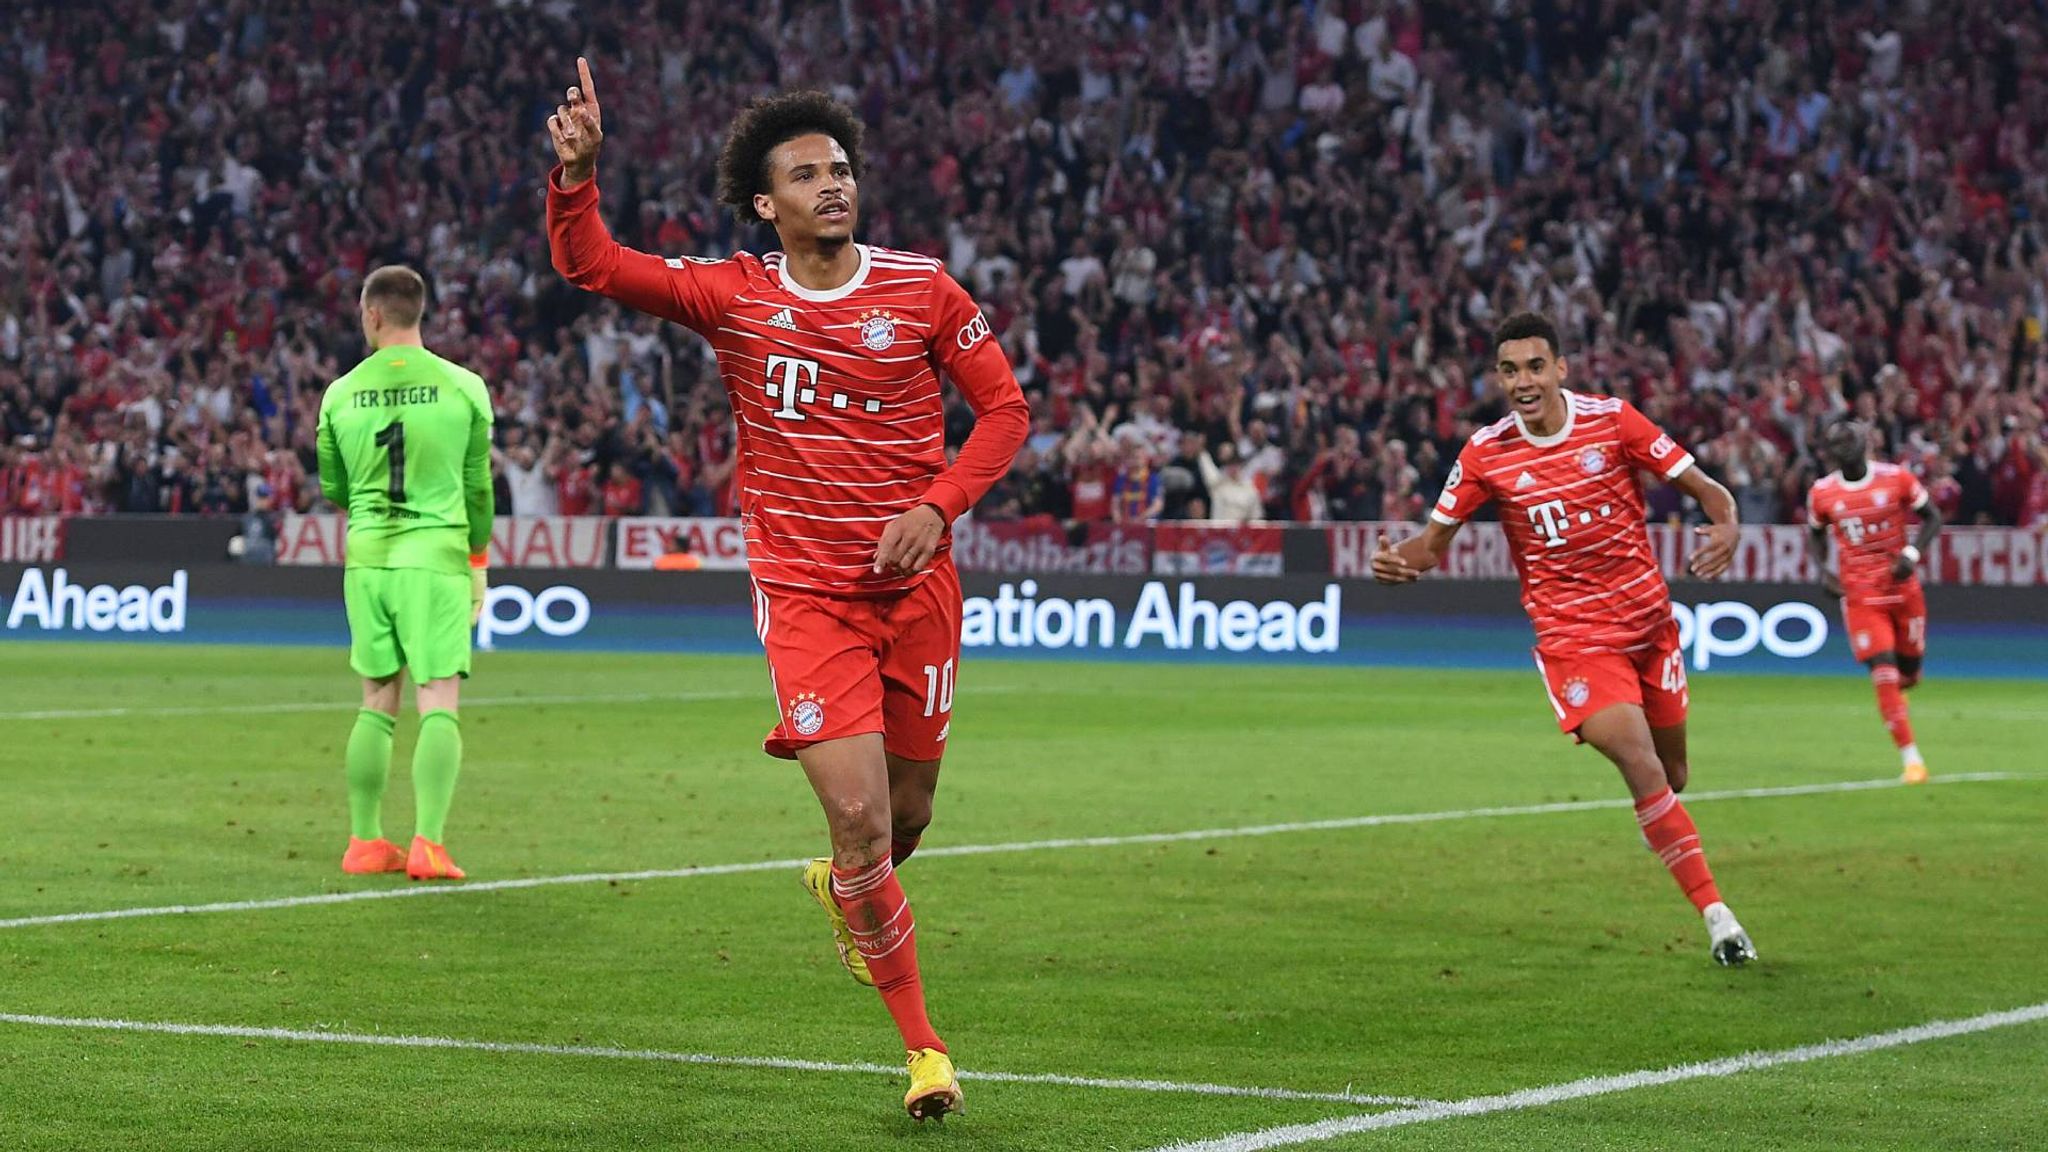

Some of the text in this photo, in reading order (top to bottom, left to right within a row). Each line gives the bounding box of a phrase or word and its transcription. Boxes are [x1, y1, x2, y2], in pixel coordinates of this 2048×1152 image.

[353, 385, 438, 409] TER STEGEN
[375, 421, 408, 504] 1
[7, 567, 188, 632] Ahead
[1124, 582, 1341, 652] Ahead
[923, 657, 954, 717] 10
